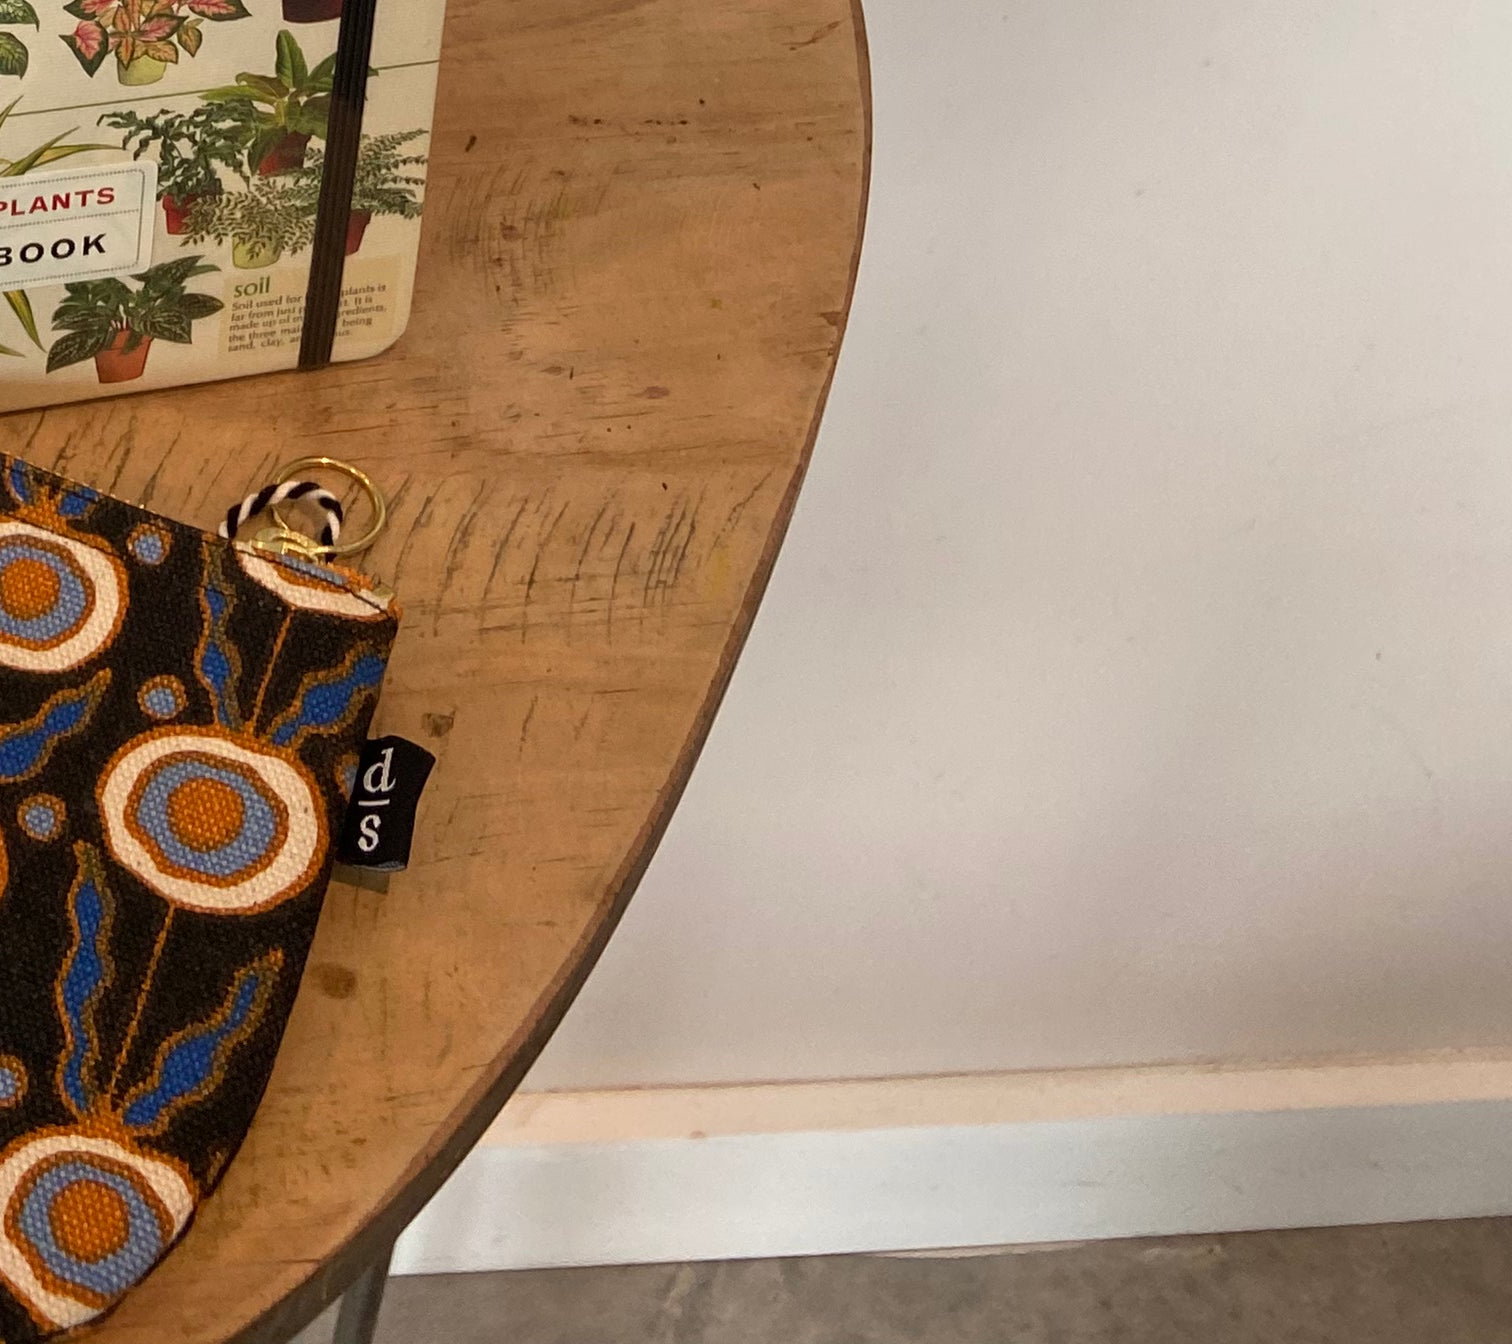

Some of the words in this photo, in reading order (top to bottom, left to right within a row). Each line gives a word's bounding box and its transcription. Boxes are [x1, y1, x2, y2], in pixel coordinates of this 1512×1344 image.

[234, 276, 270, 298] soil
[232, 299, 253, 312] Soil
[256, 296, 282, 308] used
[363, 746, 397, 794] d
[357, 814, 382, 852] s
